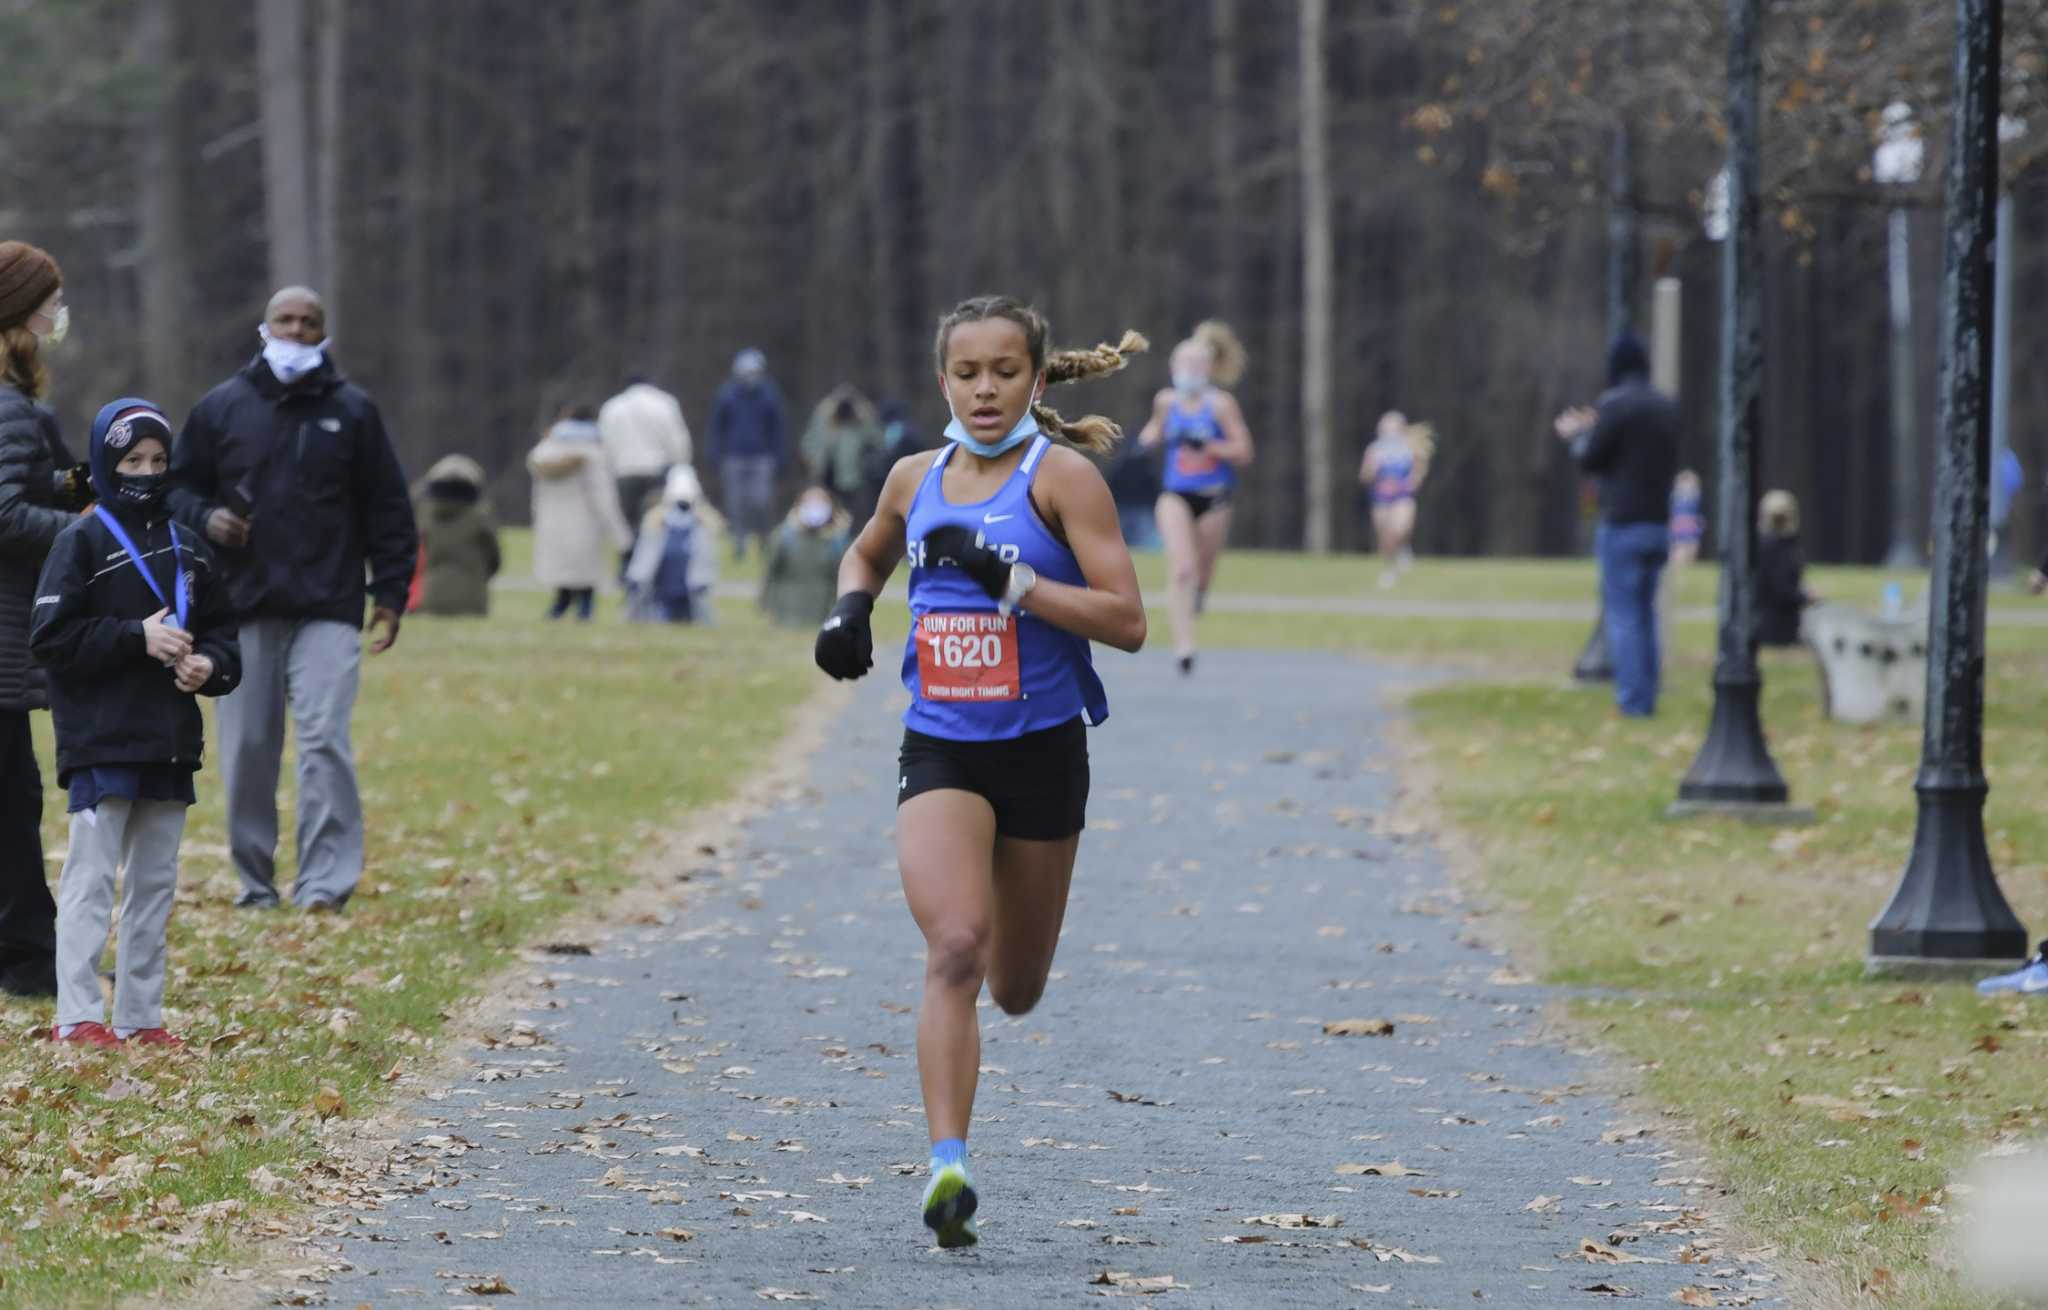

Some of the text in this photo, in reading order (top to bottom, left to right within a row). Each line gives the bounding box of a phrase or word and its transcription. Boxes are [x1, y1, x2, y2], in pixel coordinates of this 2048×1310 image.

[924, 615, 1007, 632] RUN FOR FUN
[928, 634, 1002, 668] 1620
